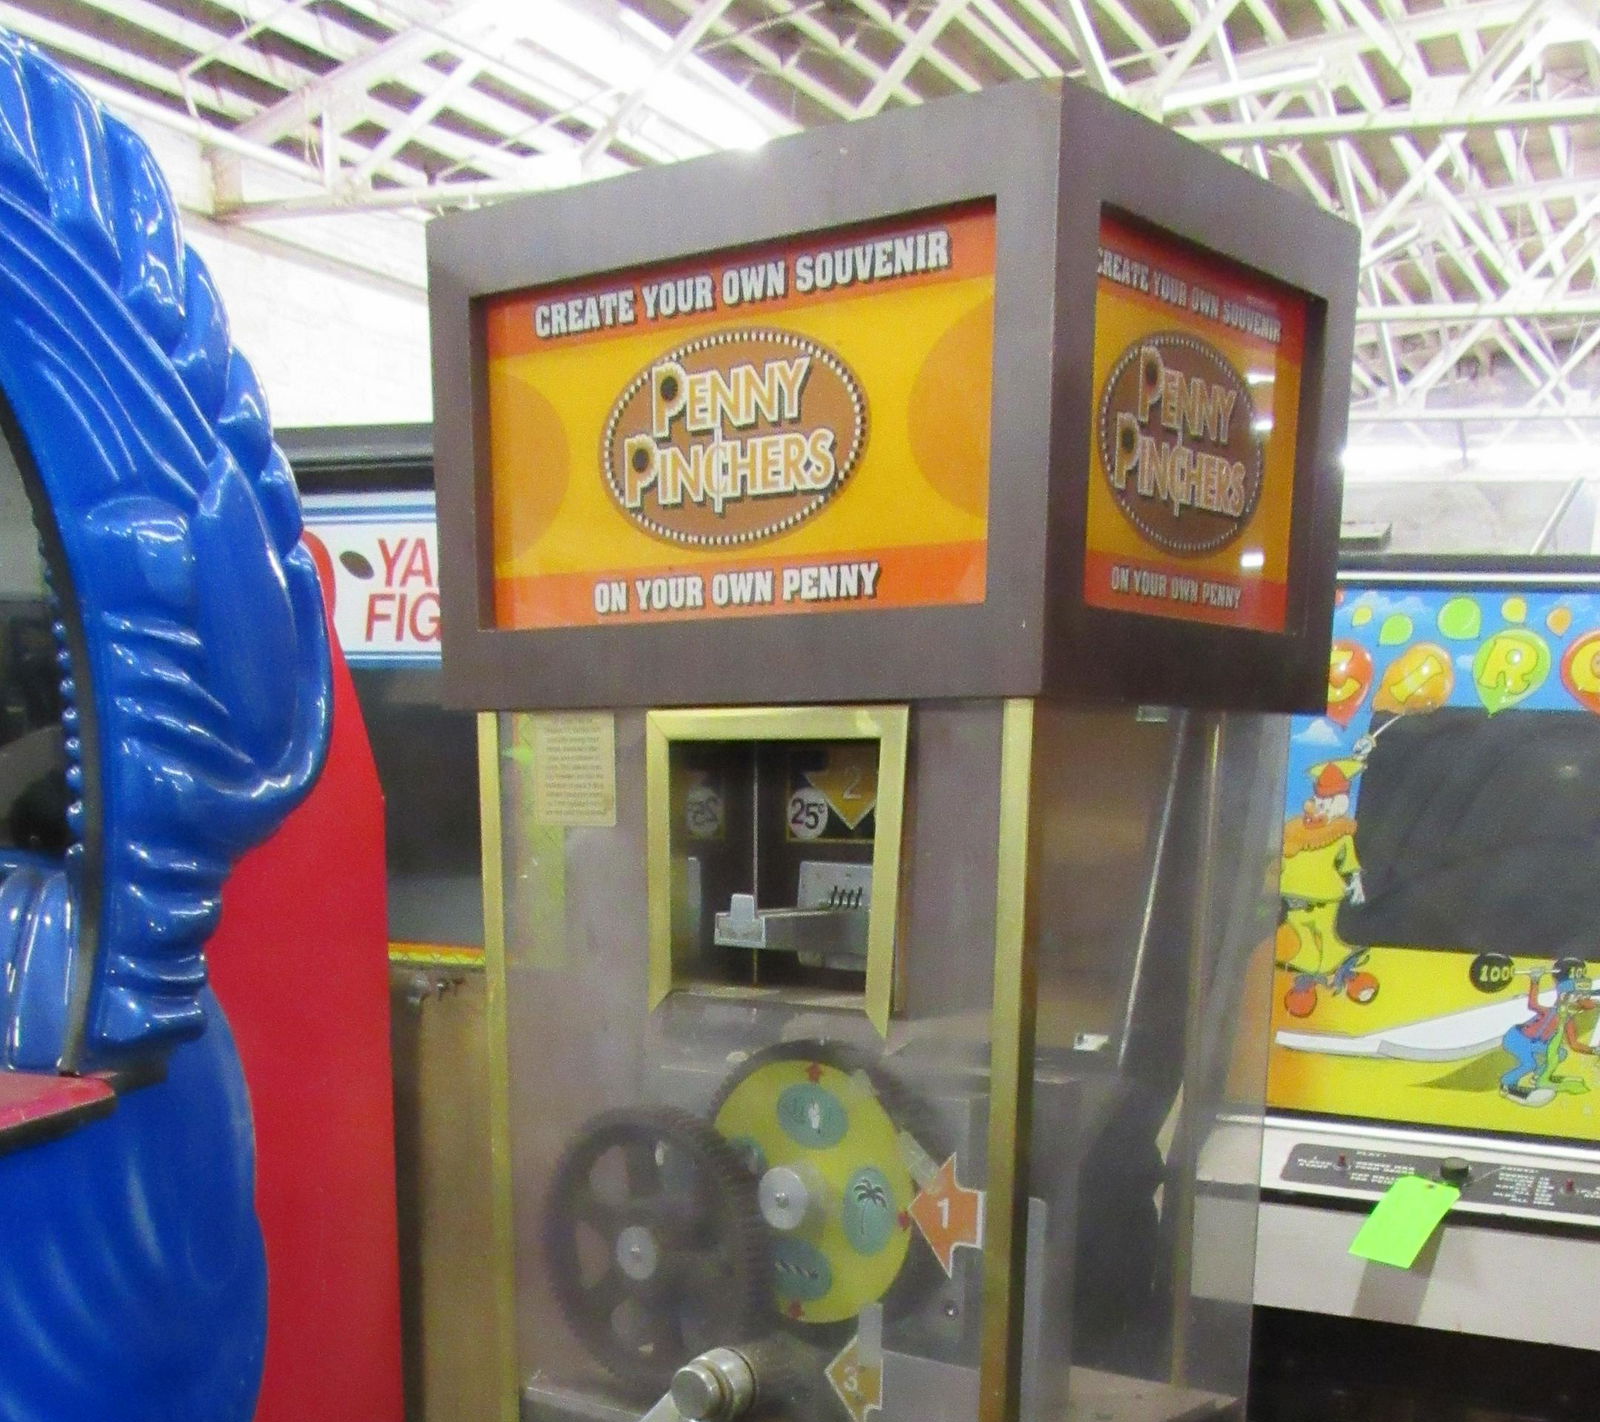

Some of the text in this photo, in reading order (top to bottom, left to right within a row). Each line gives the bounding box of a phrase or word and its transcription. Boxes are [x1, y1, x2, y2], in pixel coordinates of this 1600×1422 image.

[534, 230, 951, 338] CREATE YOUR OWN SOUVENIR
[1153, 270, 1187, 308] YOUR
[1191, 286, 1219, 320] OWN
[1223, 300, 1281, 344] SOUVENIR
[652, 354, 812, 438] PENNY
[1137, 345, 1237, 445] PENNY
[594, 562, 880, 613] ON YOUR OWN PENNY
[1111, 566, 1240, 609] ON YOUR OWN PENNY
[843, 766, 861, 799] 2
[937, 1198, 949, 1229] 1
